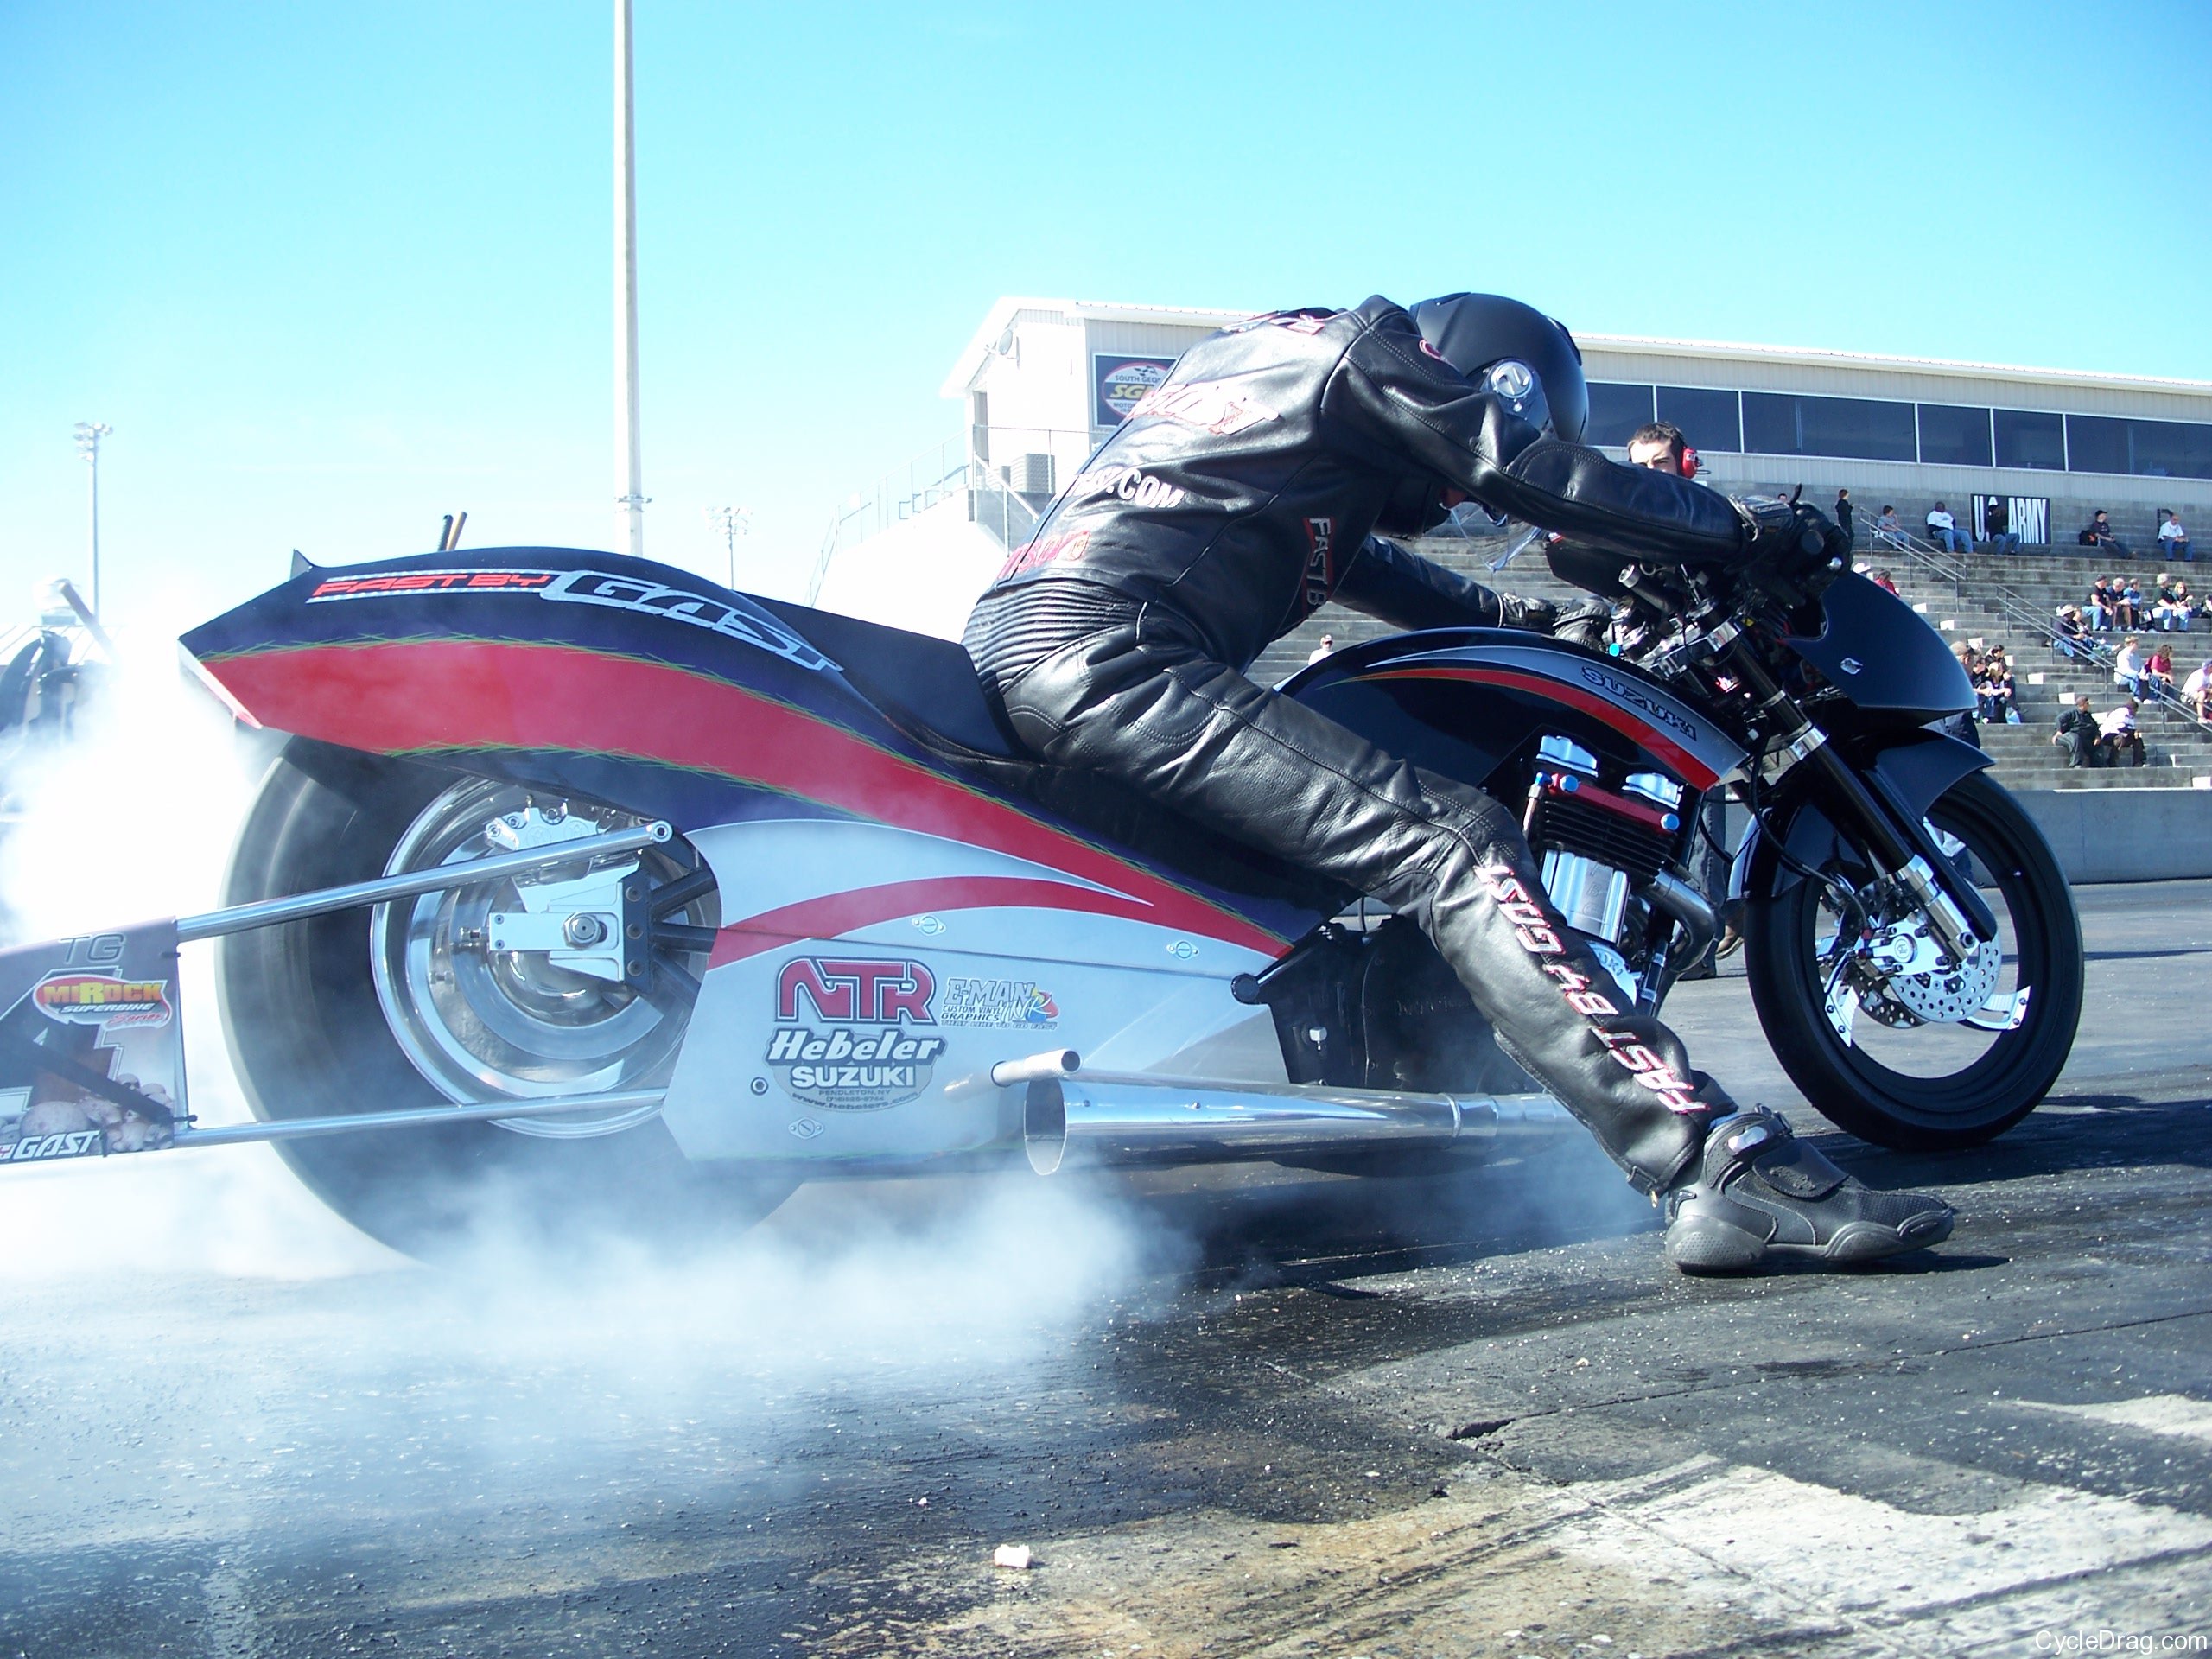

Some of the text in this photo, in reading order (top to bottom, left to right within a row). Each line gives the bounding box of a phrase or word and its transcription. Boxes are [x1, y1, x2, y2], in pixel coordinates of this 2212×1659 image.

[2008, 497, 2047, 544] ARMY
[313, 569, 844, 671] FAST BY GAST
[1580, 665, 1698, 741] SUZUKI
[59, 933, 126, 964] TG
[775, 956, 938, 1026] NTR
[944, 977, 1036, 1007] E-MAN
[60, 1002, 156, 1014] SUPERBIKE
[940, 1012, 1000, 1021] GRAPHICS
[942, 1005, 1001, 1014] CUSTOM VINYL
[766, 1029, 944, 1064] Hebeler
[791, 1066, 915, 1089] SUZUKI
[13, 1129, 101, 1160] GAST
